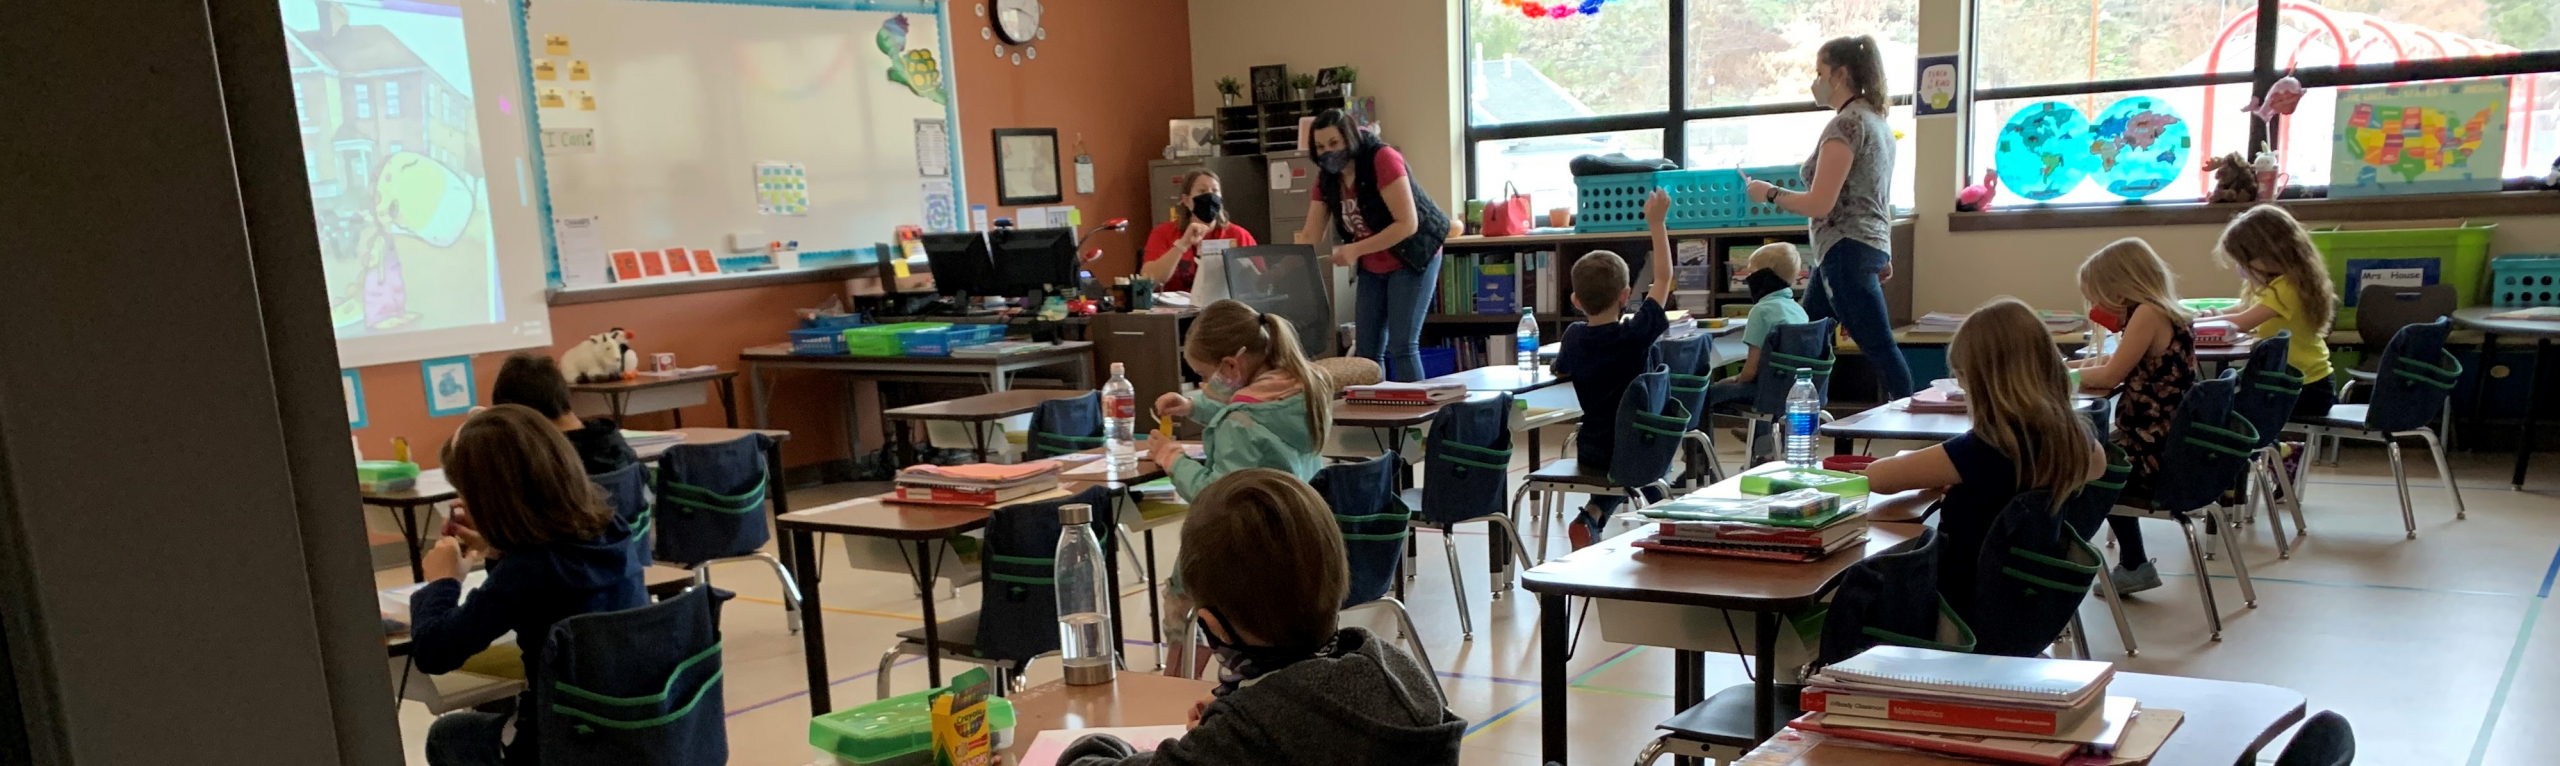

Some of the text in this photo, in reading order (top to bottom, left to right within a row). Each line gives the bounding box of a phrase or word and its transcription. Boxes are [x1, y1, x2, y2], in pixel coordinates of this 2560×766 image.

[543, 132, 556, 147] I
[2391, 271, 2421, 279] House
[1855, 703, 1886, 711] Classroom
[1893, 706, 1944, 718] Mathematics
[956, 710, 986, 725] Crayola
